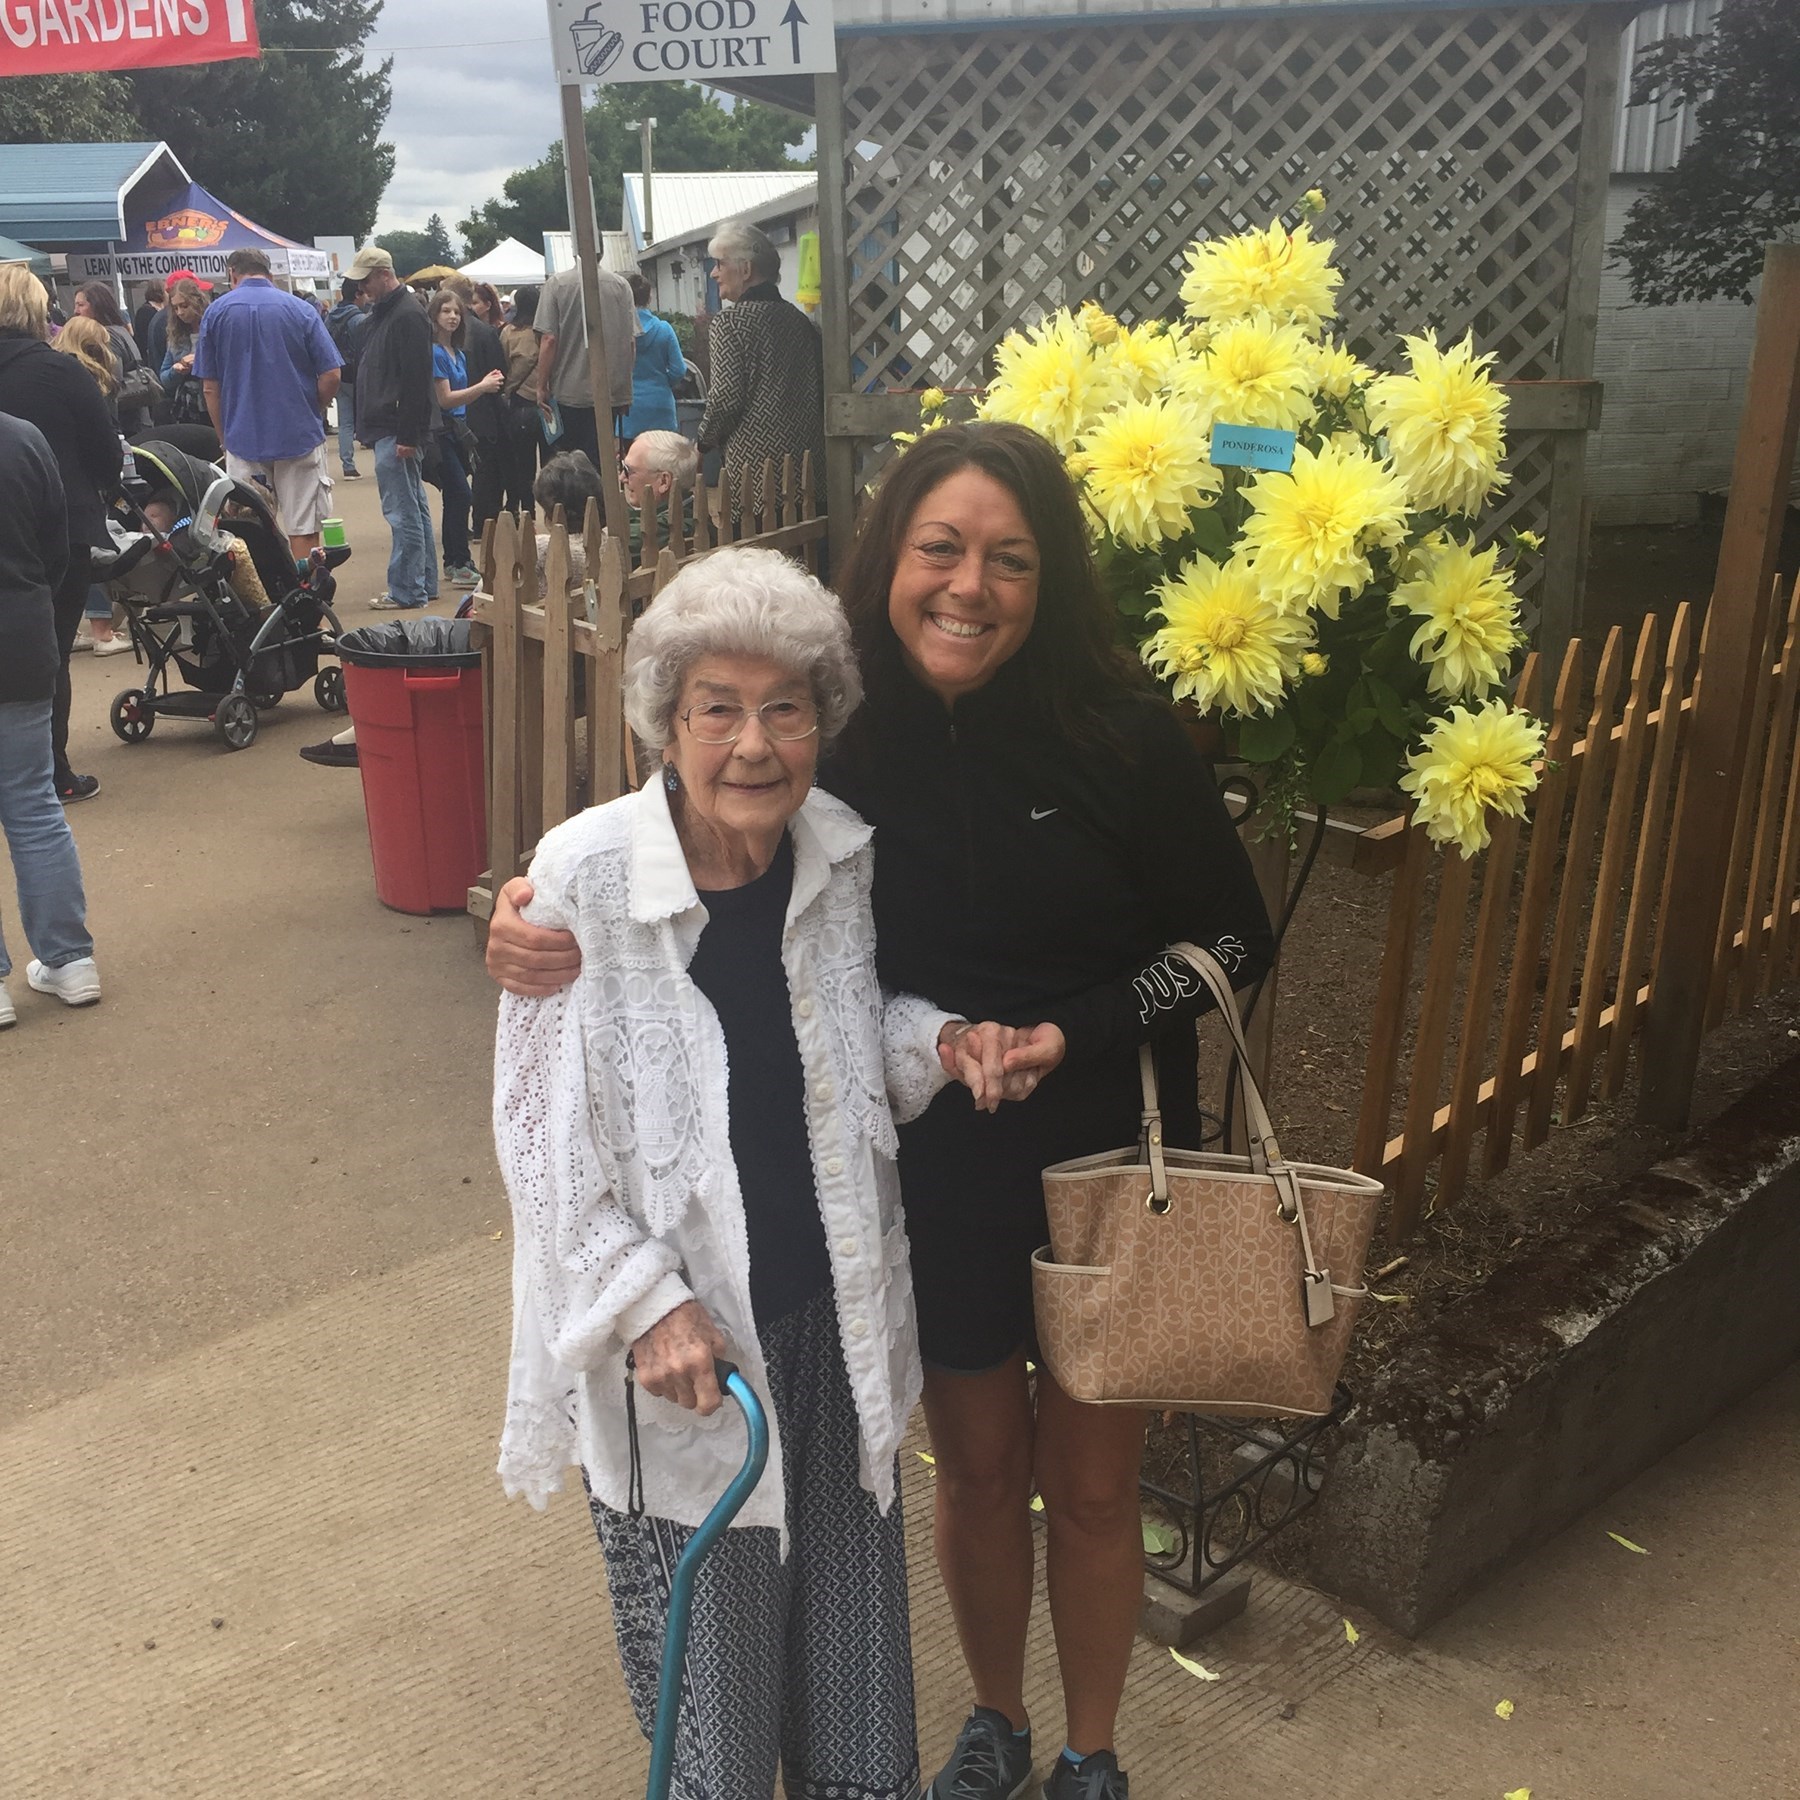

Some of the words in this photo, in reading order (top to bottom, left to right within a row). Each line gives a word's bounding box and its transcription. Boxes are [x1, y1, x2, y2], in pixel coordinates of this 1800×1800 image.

[0, 0, 210, 48] GARDENS
[639, 0, 756, 33] FOOD
[632, 36, 771, 72] COURT
[84, 257, 131, 276] LEAVNG
[131, 256, 154, 275] THE
[155, 255, 228, 274] COMPETITION
[1222, 440, 1284, 455] PONDEROSA
